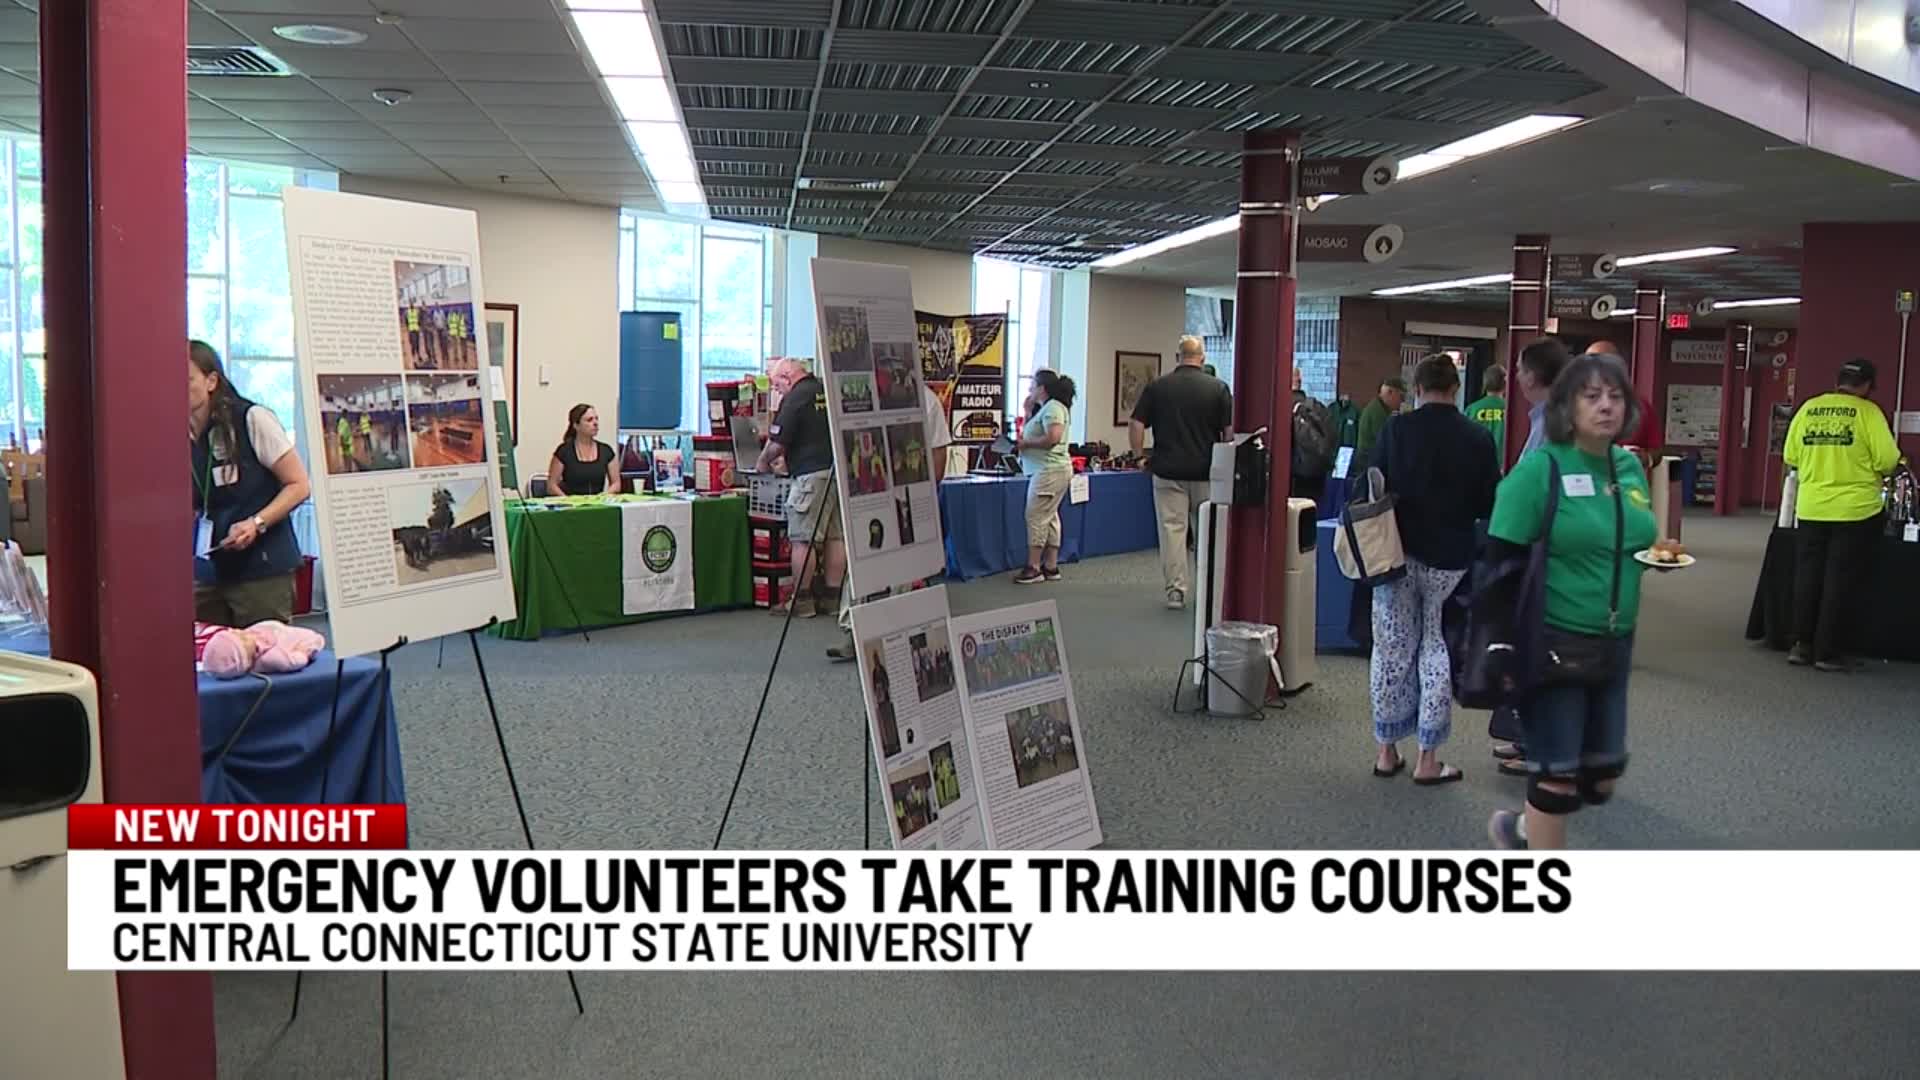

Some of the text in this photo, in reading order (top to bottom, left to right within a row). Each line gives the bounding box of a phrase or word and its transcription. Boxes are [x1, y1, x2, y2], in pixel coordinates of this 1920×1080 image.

[1304, 237, 1349, 249] MOSAIC
[955, 384, 1002, 395] AMATEUR
[961, 396, 993, 408] RADIO
[1807, 407, 1857, 418] HARTFORD
[980, 630, 995, 642] THE
[996, 623, 1032, 639] DISPATCH
